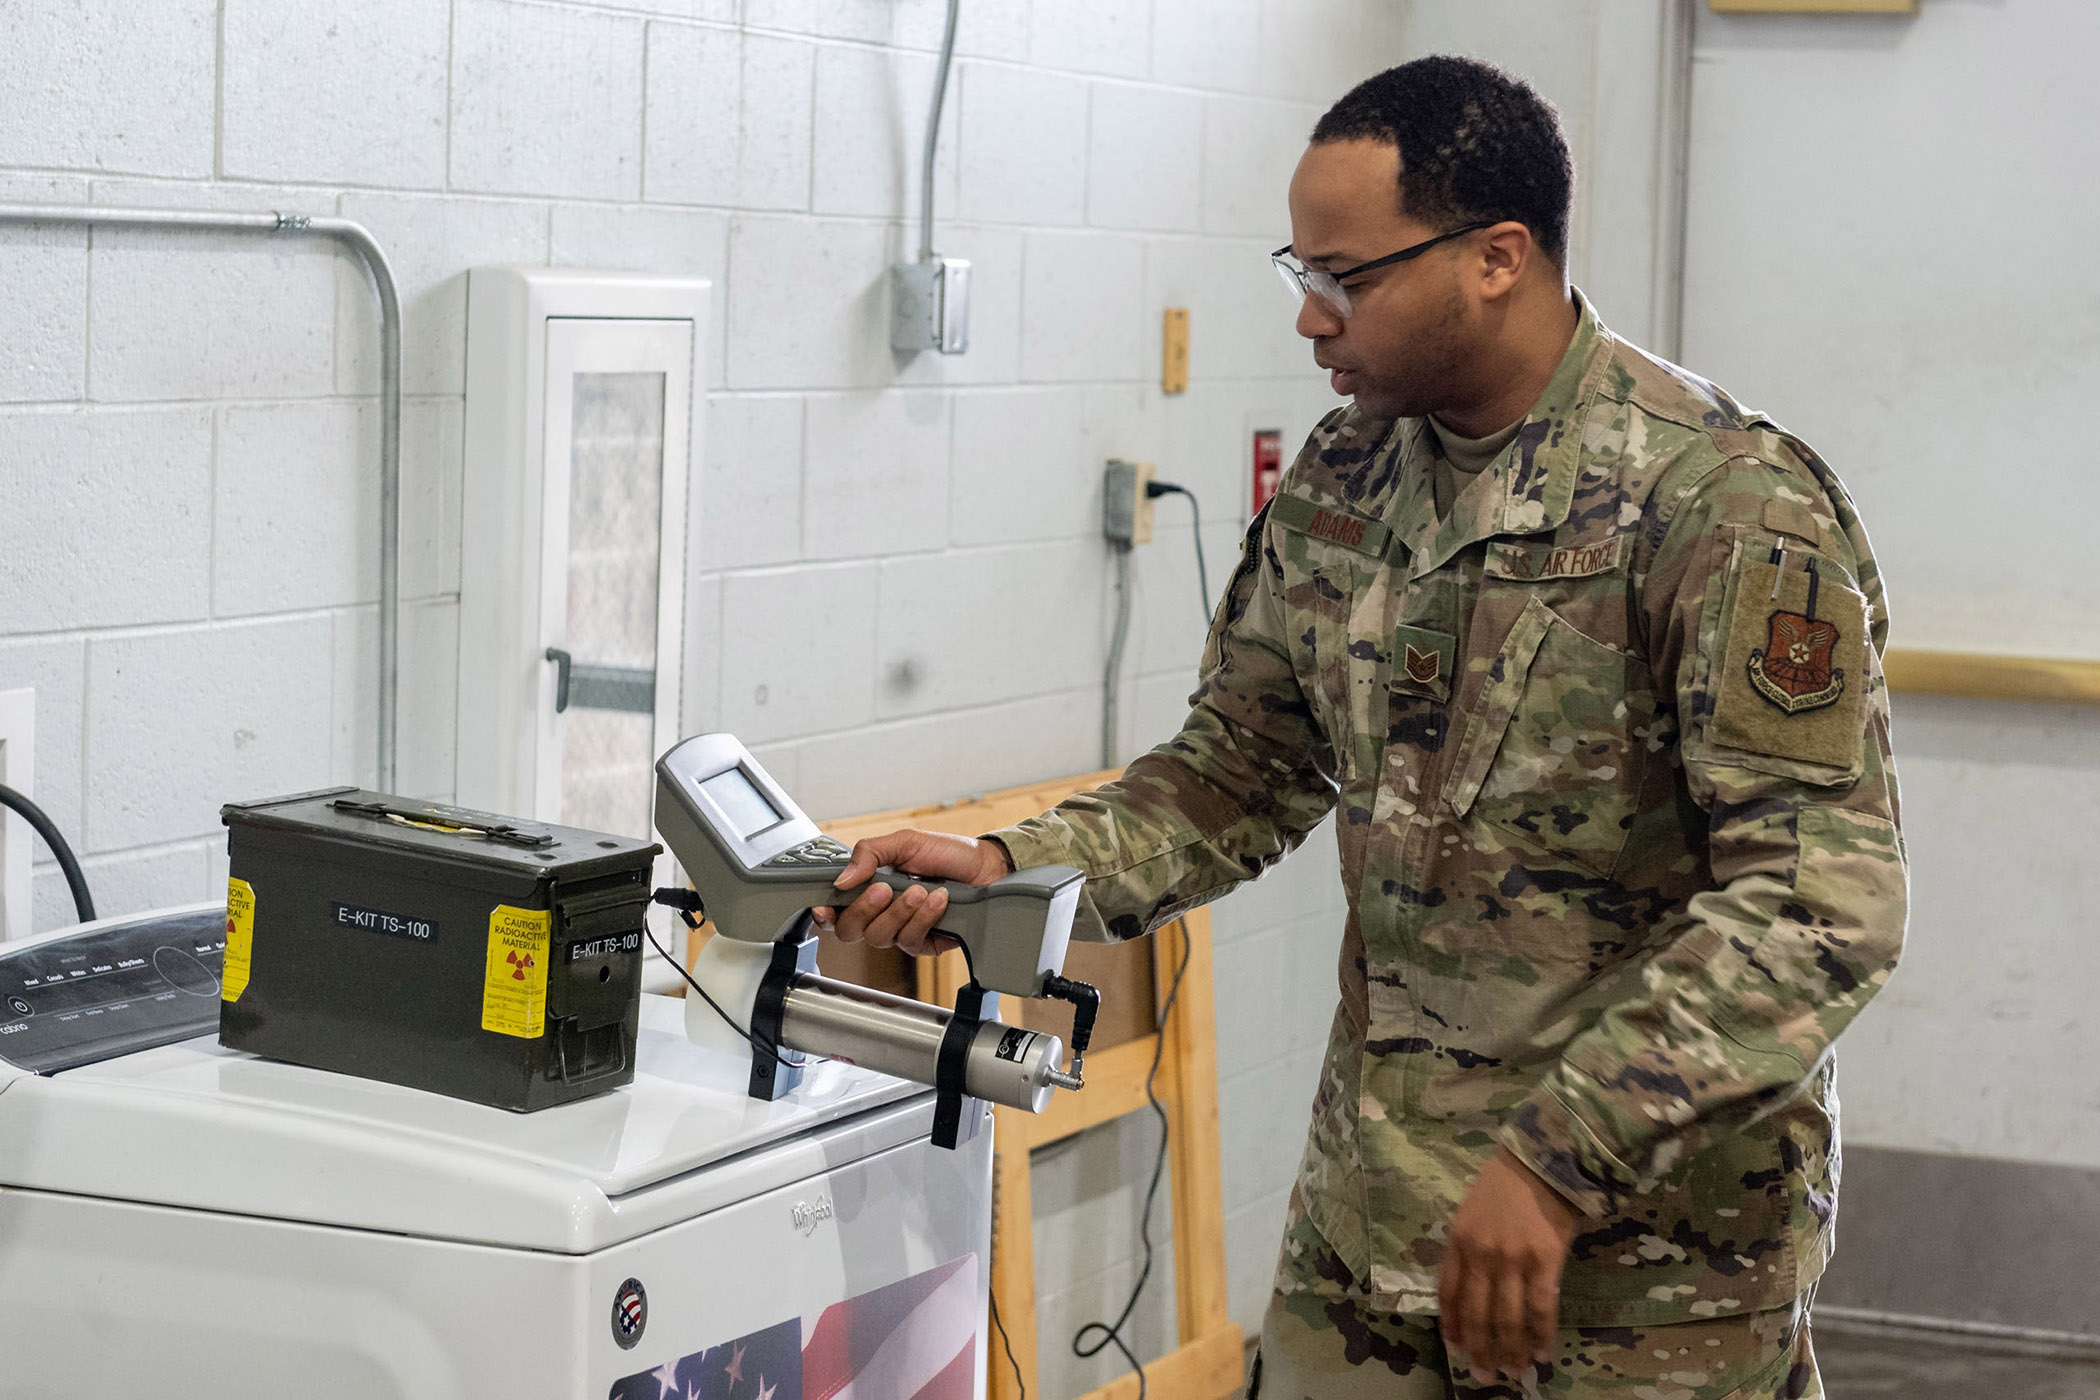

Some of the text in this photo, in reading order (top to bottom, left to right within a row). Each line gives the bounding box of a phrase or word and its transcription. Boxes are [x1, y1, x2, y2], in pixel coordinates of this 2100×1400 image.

[1308, 510, 1366, 546] ADAMS
[1540, 551, 1567, 577] AIR
[1570, 541, 1615, 575] FORCE
[338, 907, 430, 938] E-KIT TS-100
[495, 926, 547, 940] RADIOACTIVE
[504, 917, 541, 930] CAUTION
[503, 938, 540, 951] MATERIAL
[572, 933, 639, 959] E-KIT TS-100
